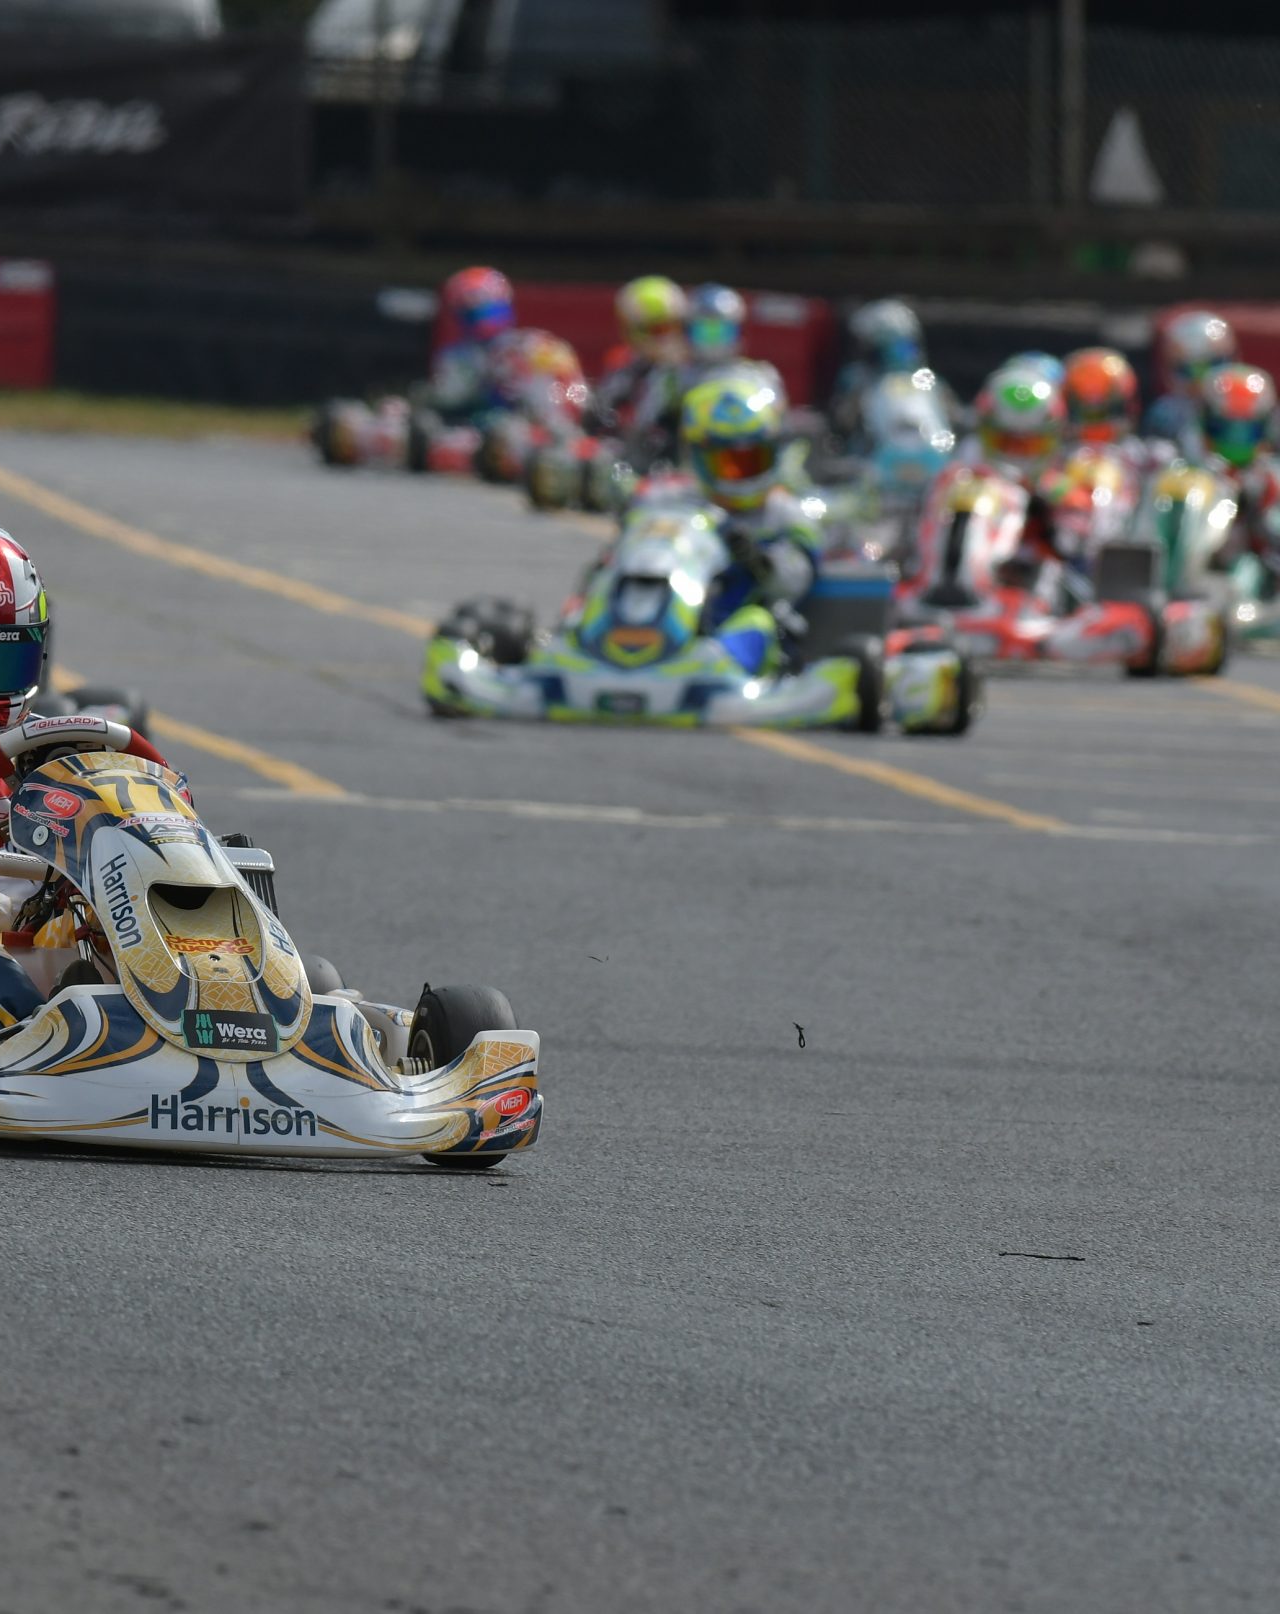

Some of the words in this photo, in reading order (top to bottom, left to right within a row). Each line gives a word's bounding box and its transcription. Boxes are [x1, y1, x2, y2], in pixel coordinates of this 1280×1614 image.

[39, 717, 91, 730] GILLARD
[88, 775, 178, 812] 77
[130, 815, 196, 828] GILLARD
[100, 853, 142, 948] Harrison
[216, 1023, 267, 1040] Wera
[501, 1095, 522, 1111] MBR
[151, 1094, 316, 1137] Harrison
